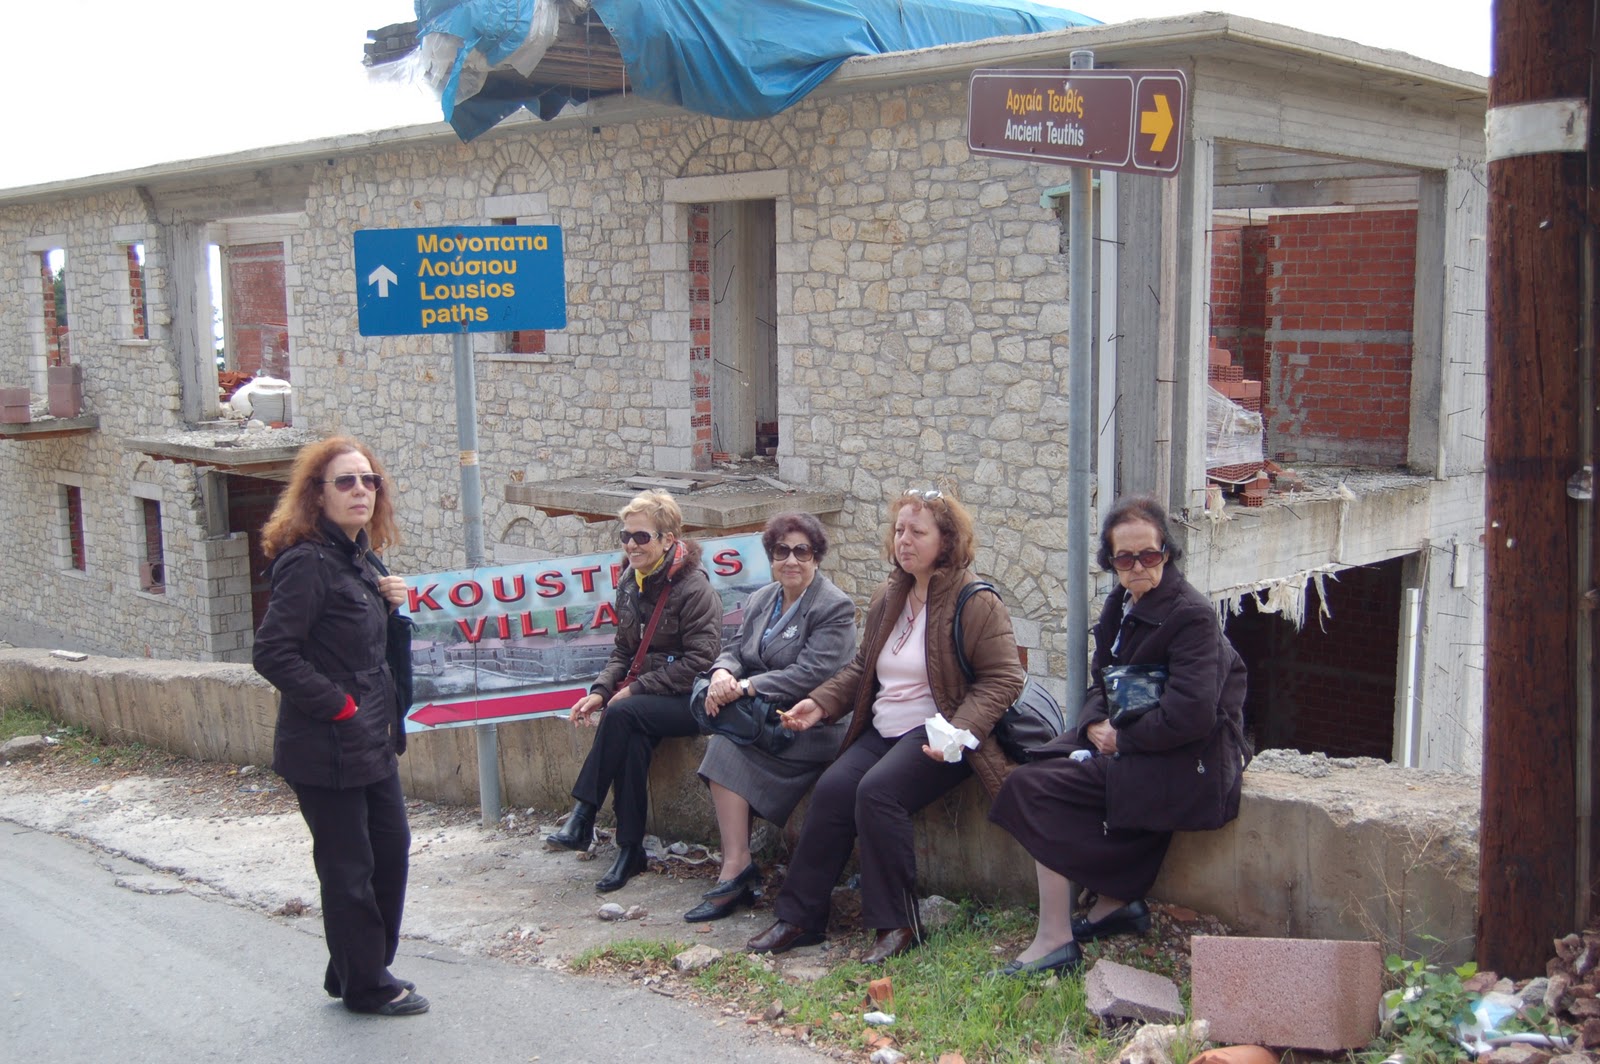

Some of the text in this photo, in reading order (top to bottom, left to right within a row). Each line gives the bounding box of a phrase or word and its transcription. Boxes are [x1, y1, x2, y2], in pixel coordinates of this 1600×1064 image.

[1006, 89, 1083, 118] Αρχαία Τευθίς
[1005, 119, 1083, 146] Ancient Teuthis
[418, 256, 517, 276] Λούσιου
[420, 280, 515, 299] Lousios
[421, 303, 489, 328] paths
[407, 548, 744, 613] KOUSTS
[456, 601, 619, 643] VILLA
